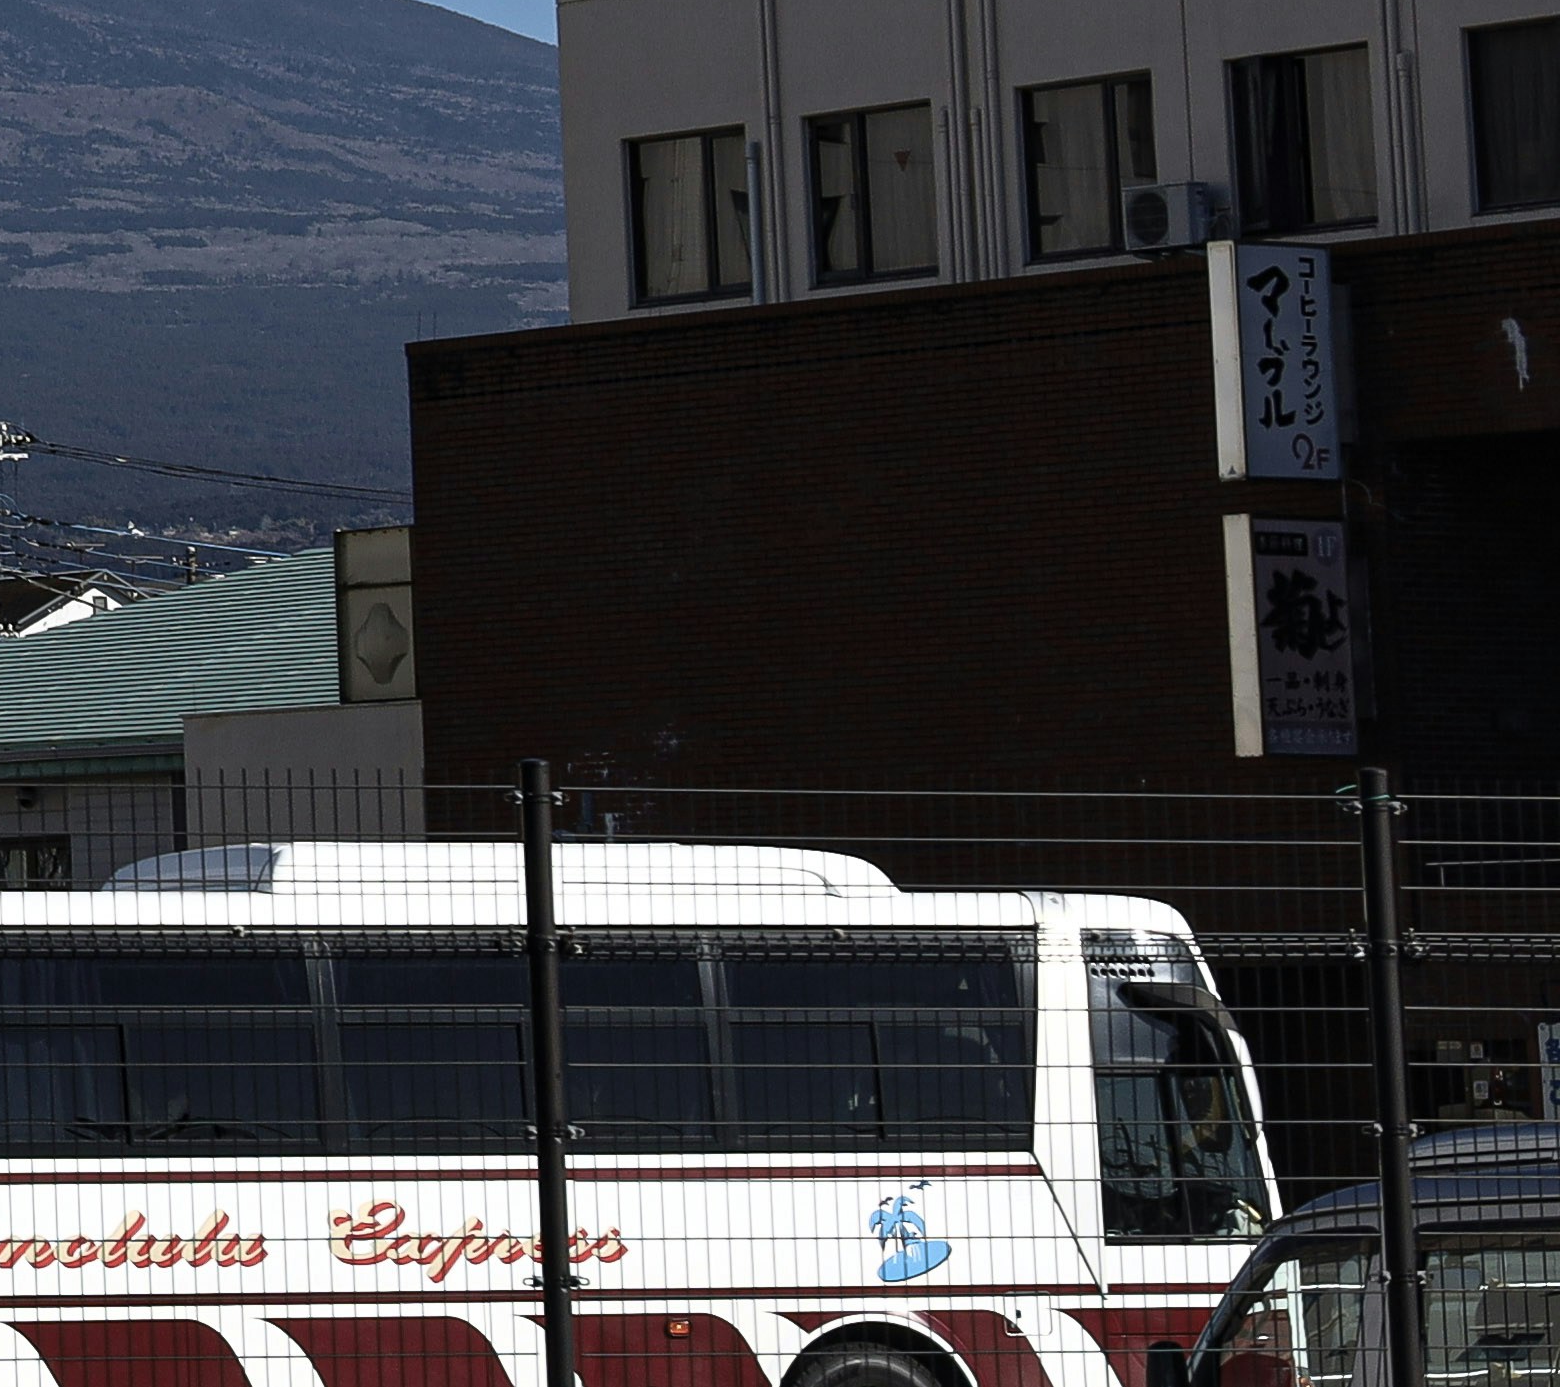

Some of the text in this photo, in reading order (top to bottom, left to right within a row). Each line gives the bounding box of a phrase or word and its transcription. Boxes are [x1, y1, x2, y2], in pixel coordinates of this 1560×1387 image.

[1297, 257, 1325, 426] コーヒーラウンジ
[1291, 433, 1329, 471] 2F
